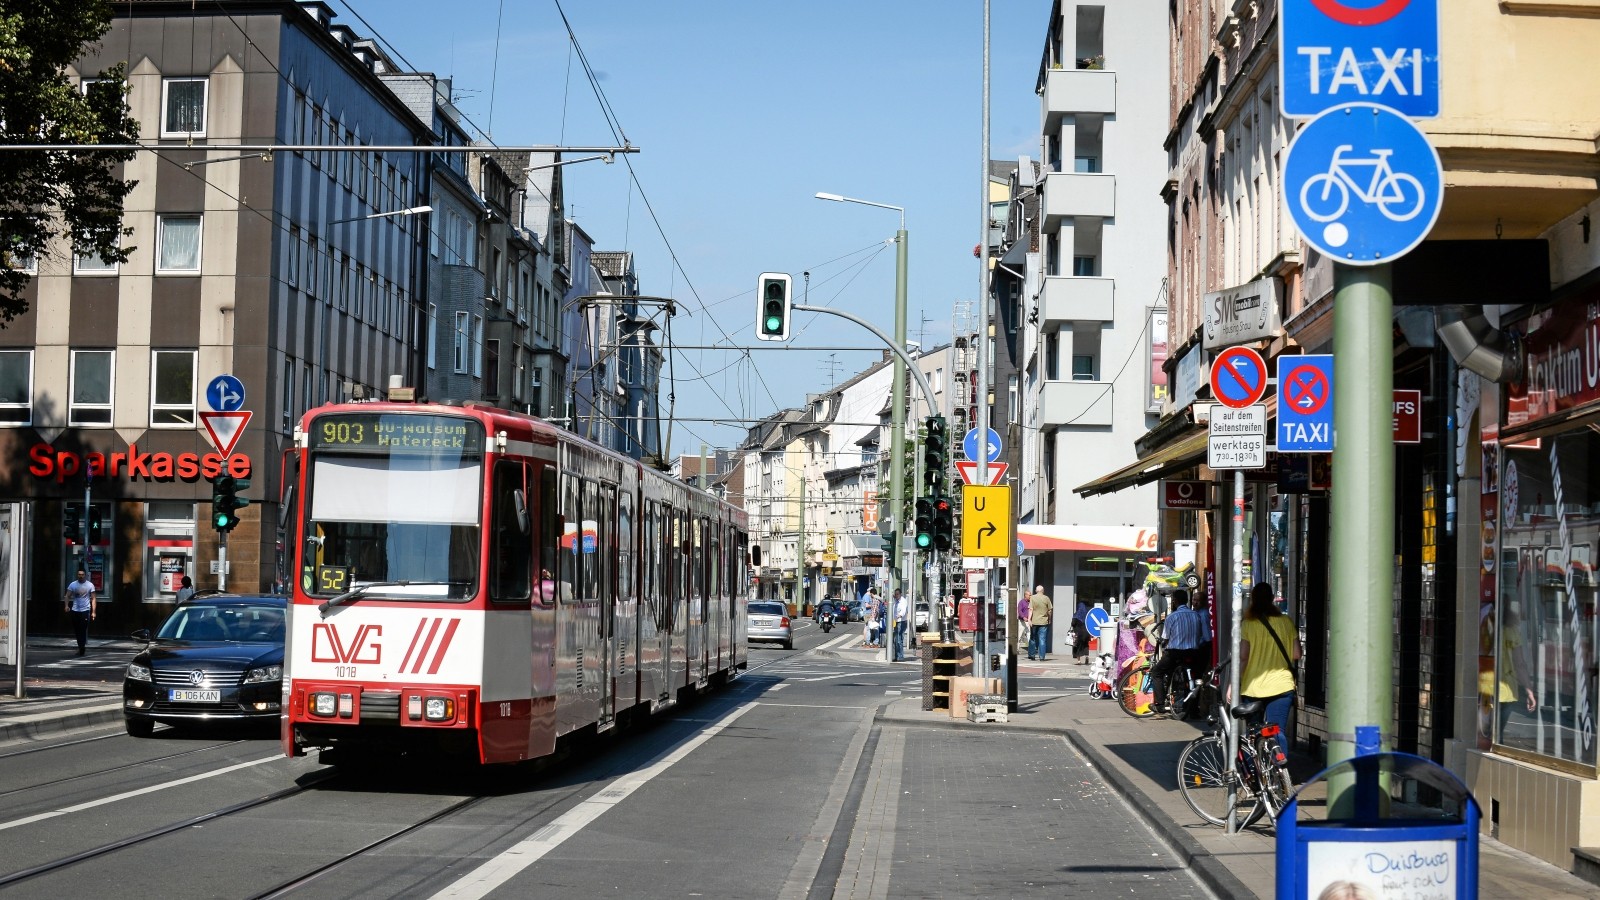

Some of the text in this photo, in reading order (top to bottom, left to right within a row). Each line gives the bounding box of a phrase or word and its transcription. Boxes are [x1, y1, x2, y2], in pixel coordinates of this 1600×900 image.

[1297, 46, 1423, 96] TAXI
[1214, 292, 1240, 326] SMC
[1223, 411, 1253, 420] auf dem
[323, 422, 364, 444] 903
[1213, 422, 1262, 433] Seitenstreifen
[1282, 422, 1329, 443] TAXI
[378, 434, 462, 448] Watereck
[1213, 440, 1261, 451] werktags
[29, 443, 251, 484] Sparkasse
[865, 491, 878, 529] FOTO
[974, 496, 986, 512] U
[322, 569, 345, 589] 52
[311, 623, 383, 664] DVG
[335, 665, 357, 678] 1018
[175, 691, 218, 701] B 106 KAN
[499, 702, 511, 717] 1018
[1365, 850, 1449, 885] Duisburg
